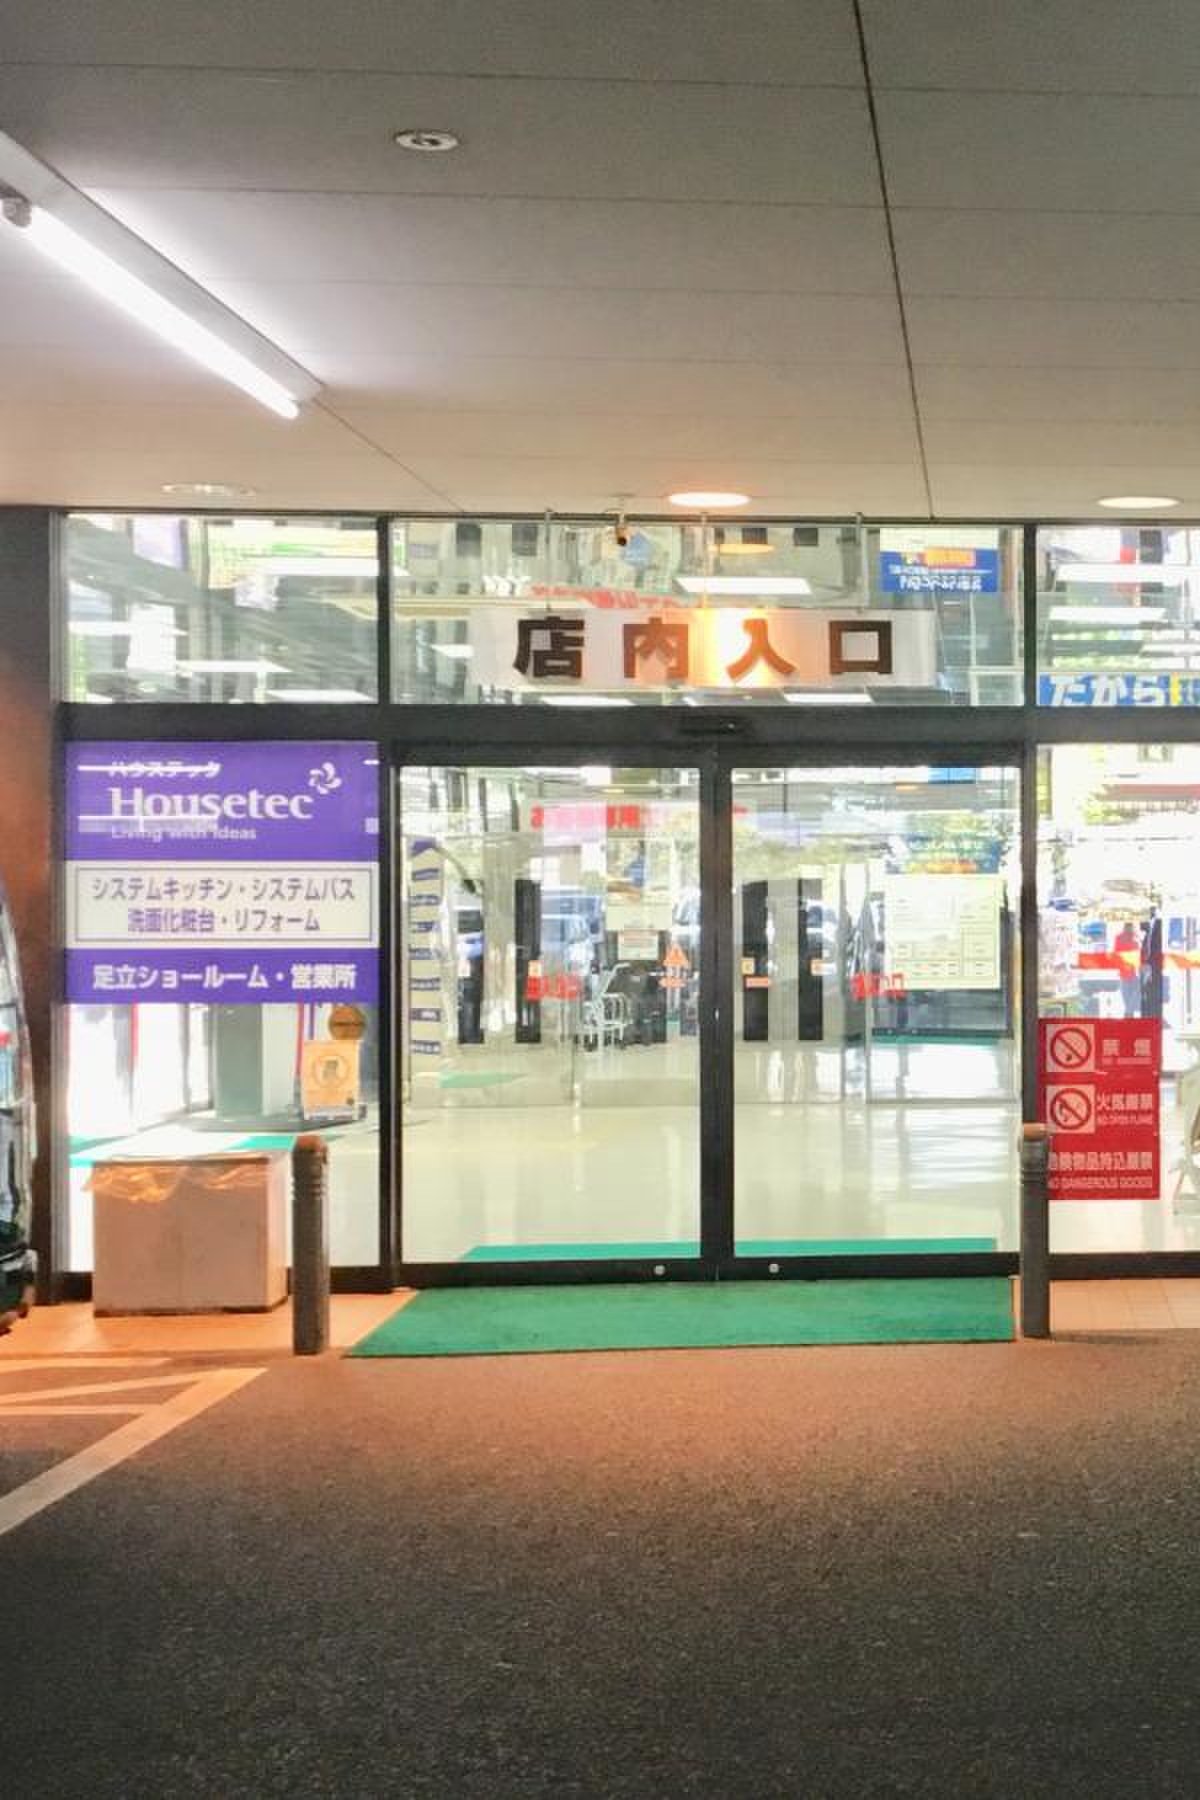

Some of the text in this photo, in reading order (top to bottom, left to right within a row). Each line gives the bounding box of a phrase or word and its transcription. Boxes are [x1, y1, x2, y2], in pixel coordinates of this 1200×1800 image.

[512, 615, 893, 680] 店内入口
[107, 787, 314, 819] Housetec
[93, 964, 357, 990] 足立ショールーム・営業所
